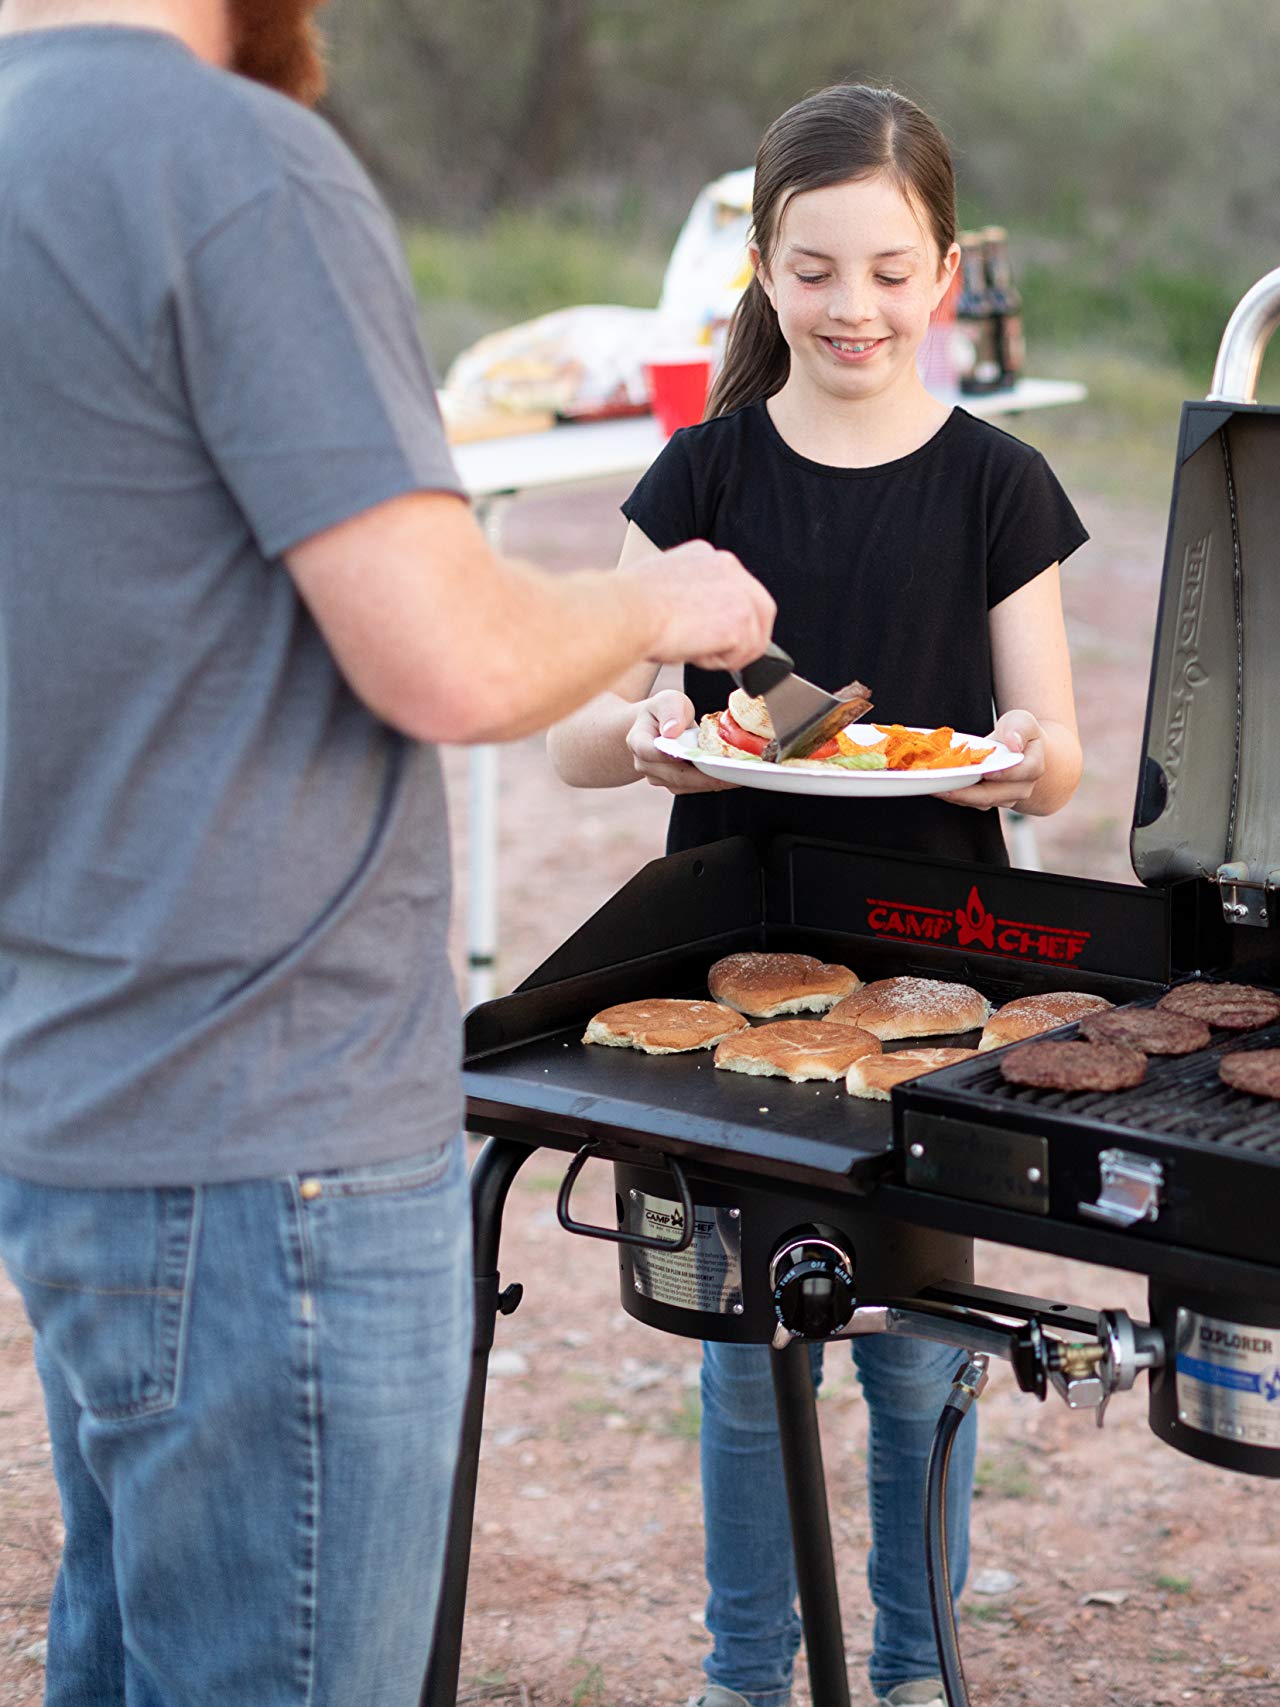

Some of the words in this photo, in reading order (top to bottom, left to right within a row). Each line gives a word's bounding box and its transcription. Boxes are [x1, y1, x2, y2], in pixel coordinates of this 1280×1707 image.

[866, 907, 953, 939] CAMP
[996, 929, 1087, 961] CHEF
[645, 1212, 670, 1224] CAMP
[694, 1223, 715, 1232] HEF
[810, 1261, 826, 1269] OFF
[779, 1270, 796, 1287] TURN
[834, 1266, 852, 1285] WARM
[1199, 1326, 1273, 1354] EXPLORER
